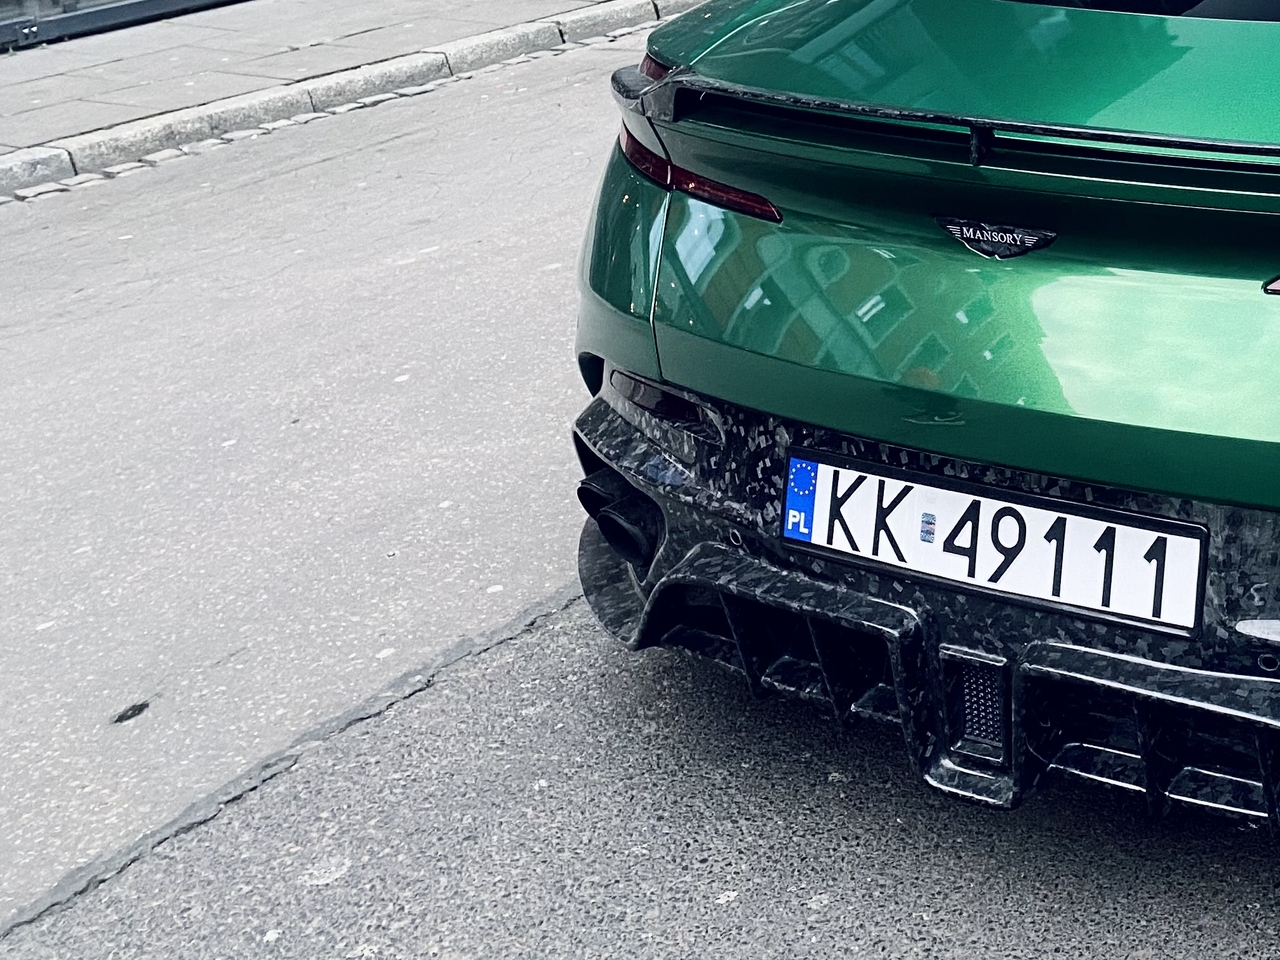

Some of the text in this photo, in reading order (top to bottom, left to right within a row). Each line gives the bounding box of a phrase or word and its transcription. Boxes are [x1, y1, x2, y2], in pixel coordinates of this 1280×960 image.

[962, 226, 1022, 245] MANSORY
[787, 509, 809, 534] PL
[826, 469, 1168, 619] KK 49111
